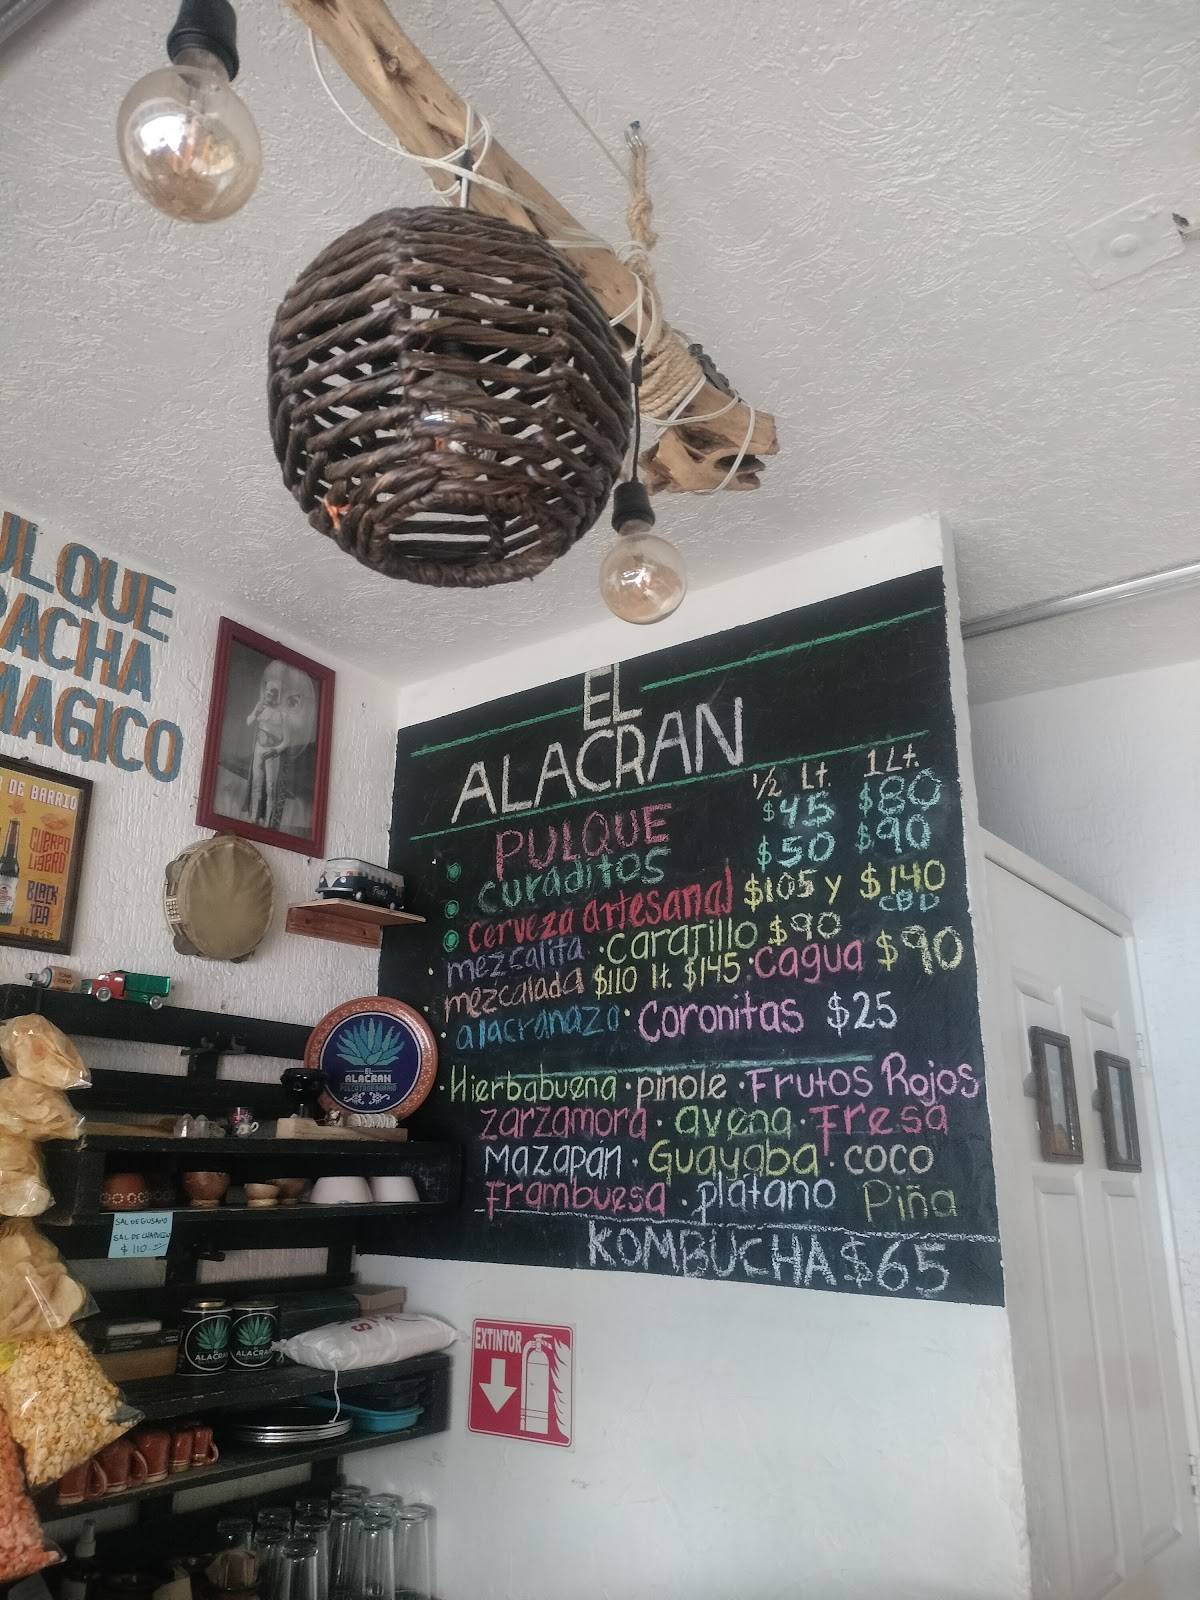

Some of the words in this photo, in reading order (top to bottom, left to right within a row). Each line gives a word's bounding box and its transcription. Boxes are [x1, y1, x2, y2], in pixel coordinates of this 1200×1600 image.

[0, 585, 151, 702] ACHA
[583, 661, 643, 731] EL
[451, 696, 744, 824] ALACRAN
[8, 778, 26, 797] DE
[30, 786, 78, 810] BARRIO
[495, 802, 673, 882] PULQUE
[583, 858, 735, 934] artesanal
[744, 868, 818, 913] $105
[860, 859, 946, 901] $140
[444, 966, 585, 1023] mezcalada
[592, 962, 638, 1000] $110
[684, 952, 741, 993] $145
[446, 935, 585, 988] mezcalita
[456, 1002, 620, 1050] alacranazo
[827, 990, 898, 1039] $25
[344, 1074, 392, 1083] ALACRAN
[451, 1063, 618, 1103] Hierbabuena
[637, 1067, 727, 1110] pinole
[745, 1065, 873, 1103] Frutos
[881, 1051, 980, 1107] Rojos
[674, 1104, 792, 1141] avena
[808, 1102, 948, 1157] Fresa
[648, 1138, 819, 1188] Guayaba
[115, 1217, 129, 1226] SAL
[485, 1175, 667, 1222] Frambuesa
[862, 1178, 958, 1223] Piña
[588, 1219, 837, 1288] KOMBUCHA
[840, 1235, 951, 1299] $65
[236, 1348, 272, 1357] ALACRA
[475, 1326, 522, 1353] EXTINTOR
